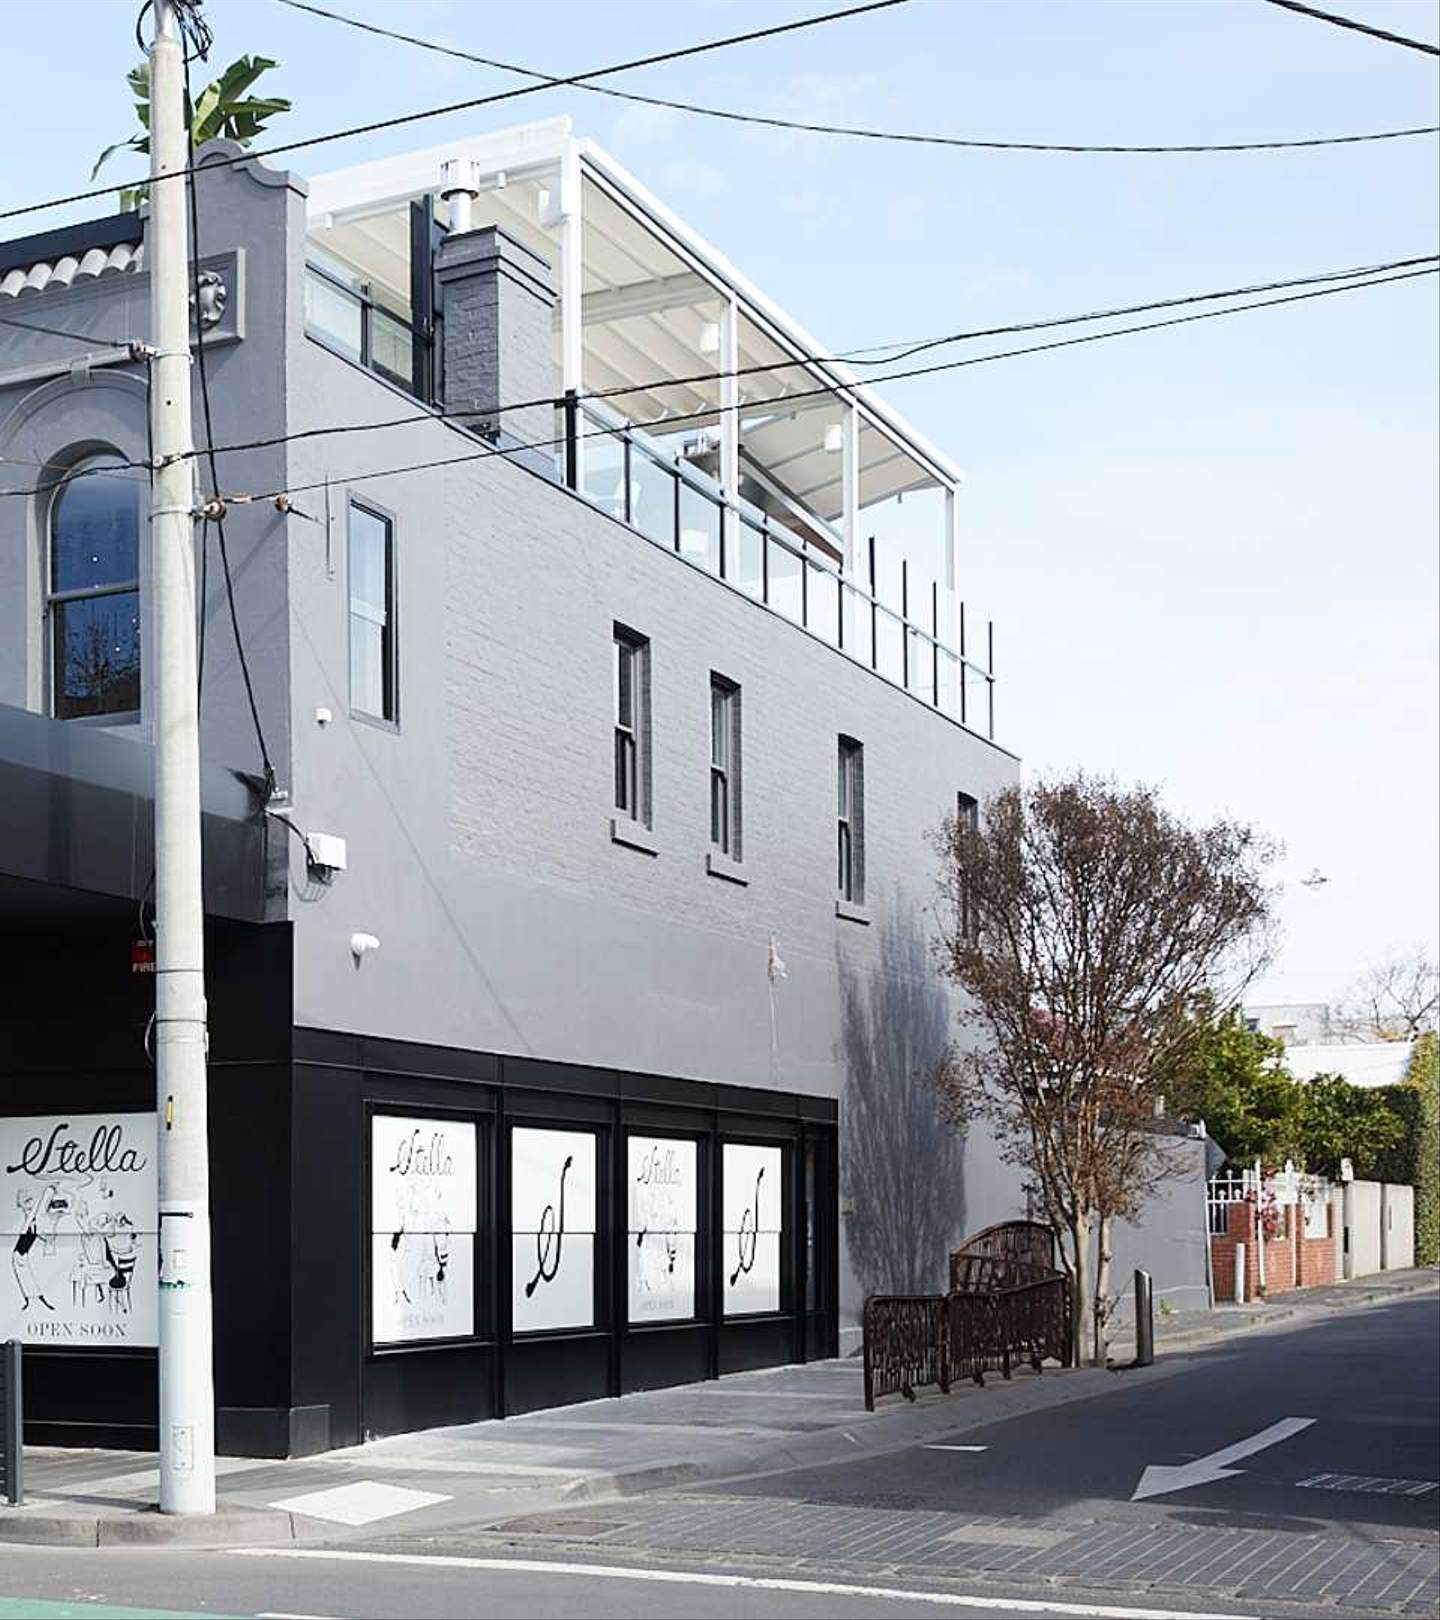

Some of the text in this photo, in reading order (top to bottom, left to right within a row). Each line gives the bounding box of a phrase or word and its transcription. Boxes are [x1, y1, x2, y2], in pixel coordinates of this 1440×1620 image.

[6, 1123, 148, 1175] Stella
[389, 1129, 454, 1176] Stella
[27, 1321, 126, 1338] OPEN SOON
